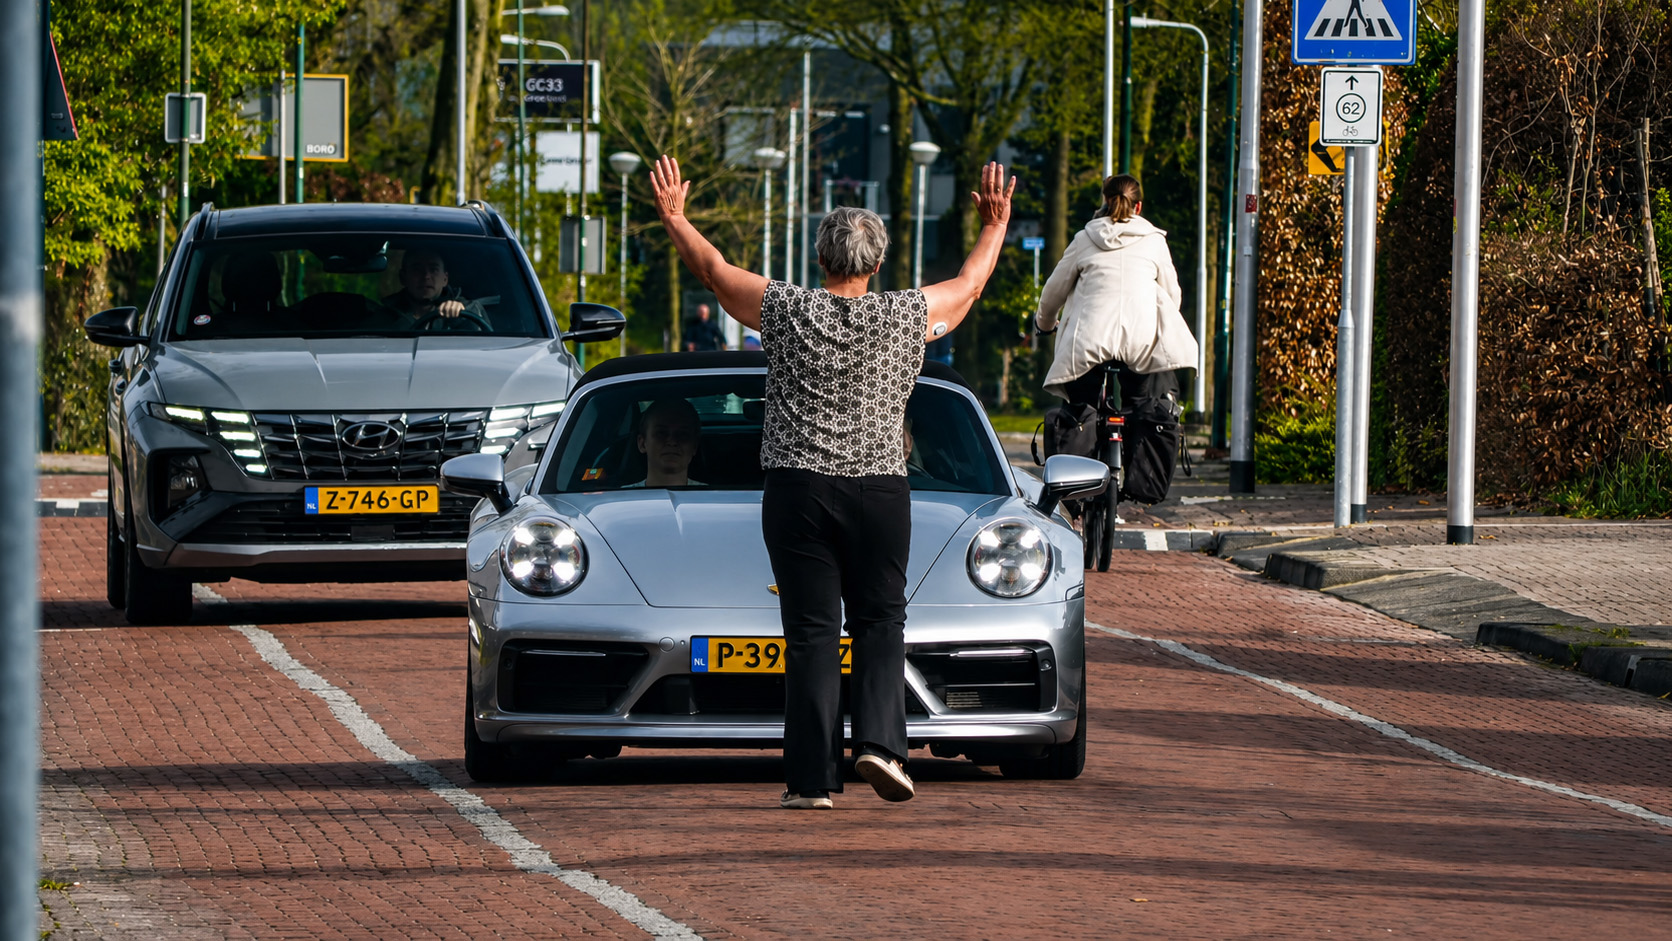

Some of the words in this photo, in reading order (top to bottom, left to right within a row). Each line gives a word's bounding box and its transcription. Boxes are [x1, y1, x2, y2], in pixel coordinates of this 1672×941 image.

[1342, 102, 1360, 115] 62
[326, 490, 429, 510] Z-746-GP
[694, 658, 706, 666] NL
